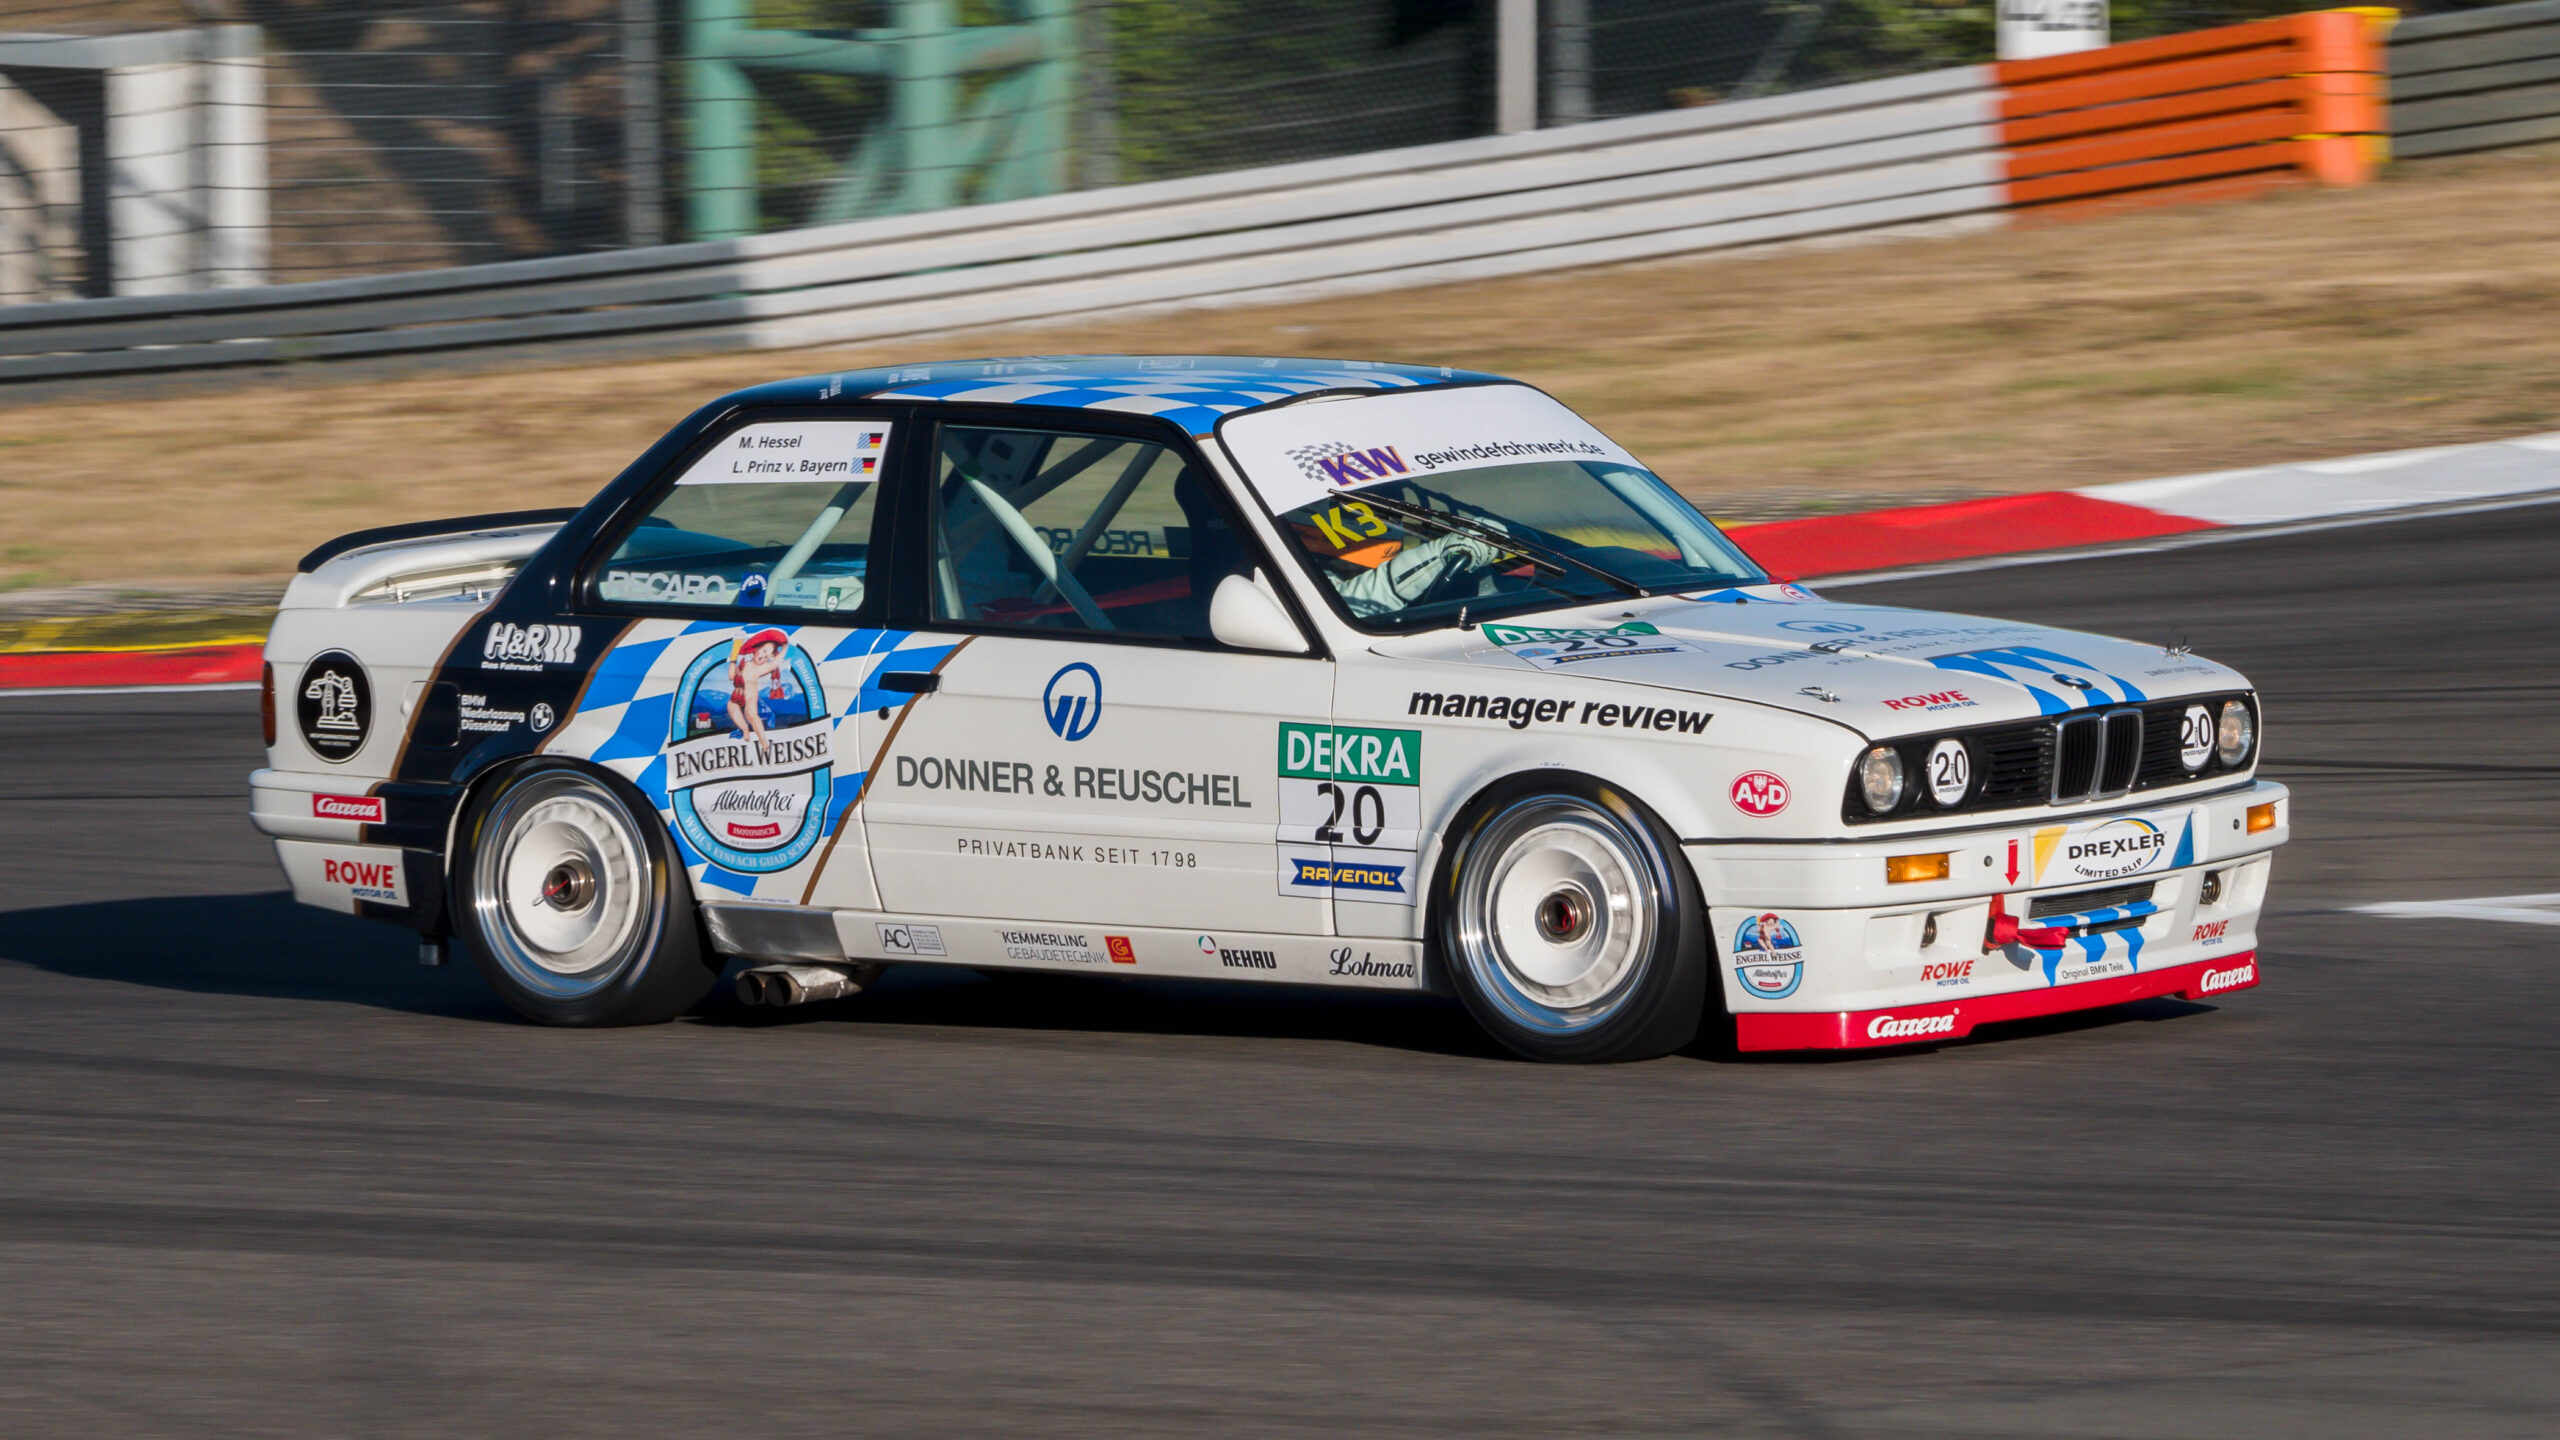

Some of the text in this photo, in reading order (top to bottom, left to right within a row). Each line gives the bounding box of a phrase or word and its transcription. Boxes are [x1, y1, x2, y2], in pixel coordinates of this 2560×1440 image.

[738, 435, 802, 449] M. Hessel
[1317, 445, 1411, 487] KW
[1414, 441, 1605, 470] gewindefahrwerk.de
[732, 460, 848, 477] L. Prinz v. Bayern
[1310, 502, 1388, 550] K3
[606, 571, 727, 600] RECARO
[484, 622, 550, 662] H&R
[1494, 628, 1650, 645] DEKRA
[1549, 637, 1639, 652] 20
[1561, 648, 1668, 663] RAVENOL
[461, 695, 487, 707] BMW
[1883, 690, 1971, 711] ROWE
[1926, 700, 1979, 713] MOTOR OIL
[461, 707, 526, 723] Niederlassung
[1407, 691, 1715, 735] manager review
[461, 719, 511, 732] Düsseldorf
[2181, 713, 2211, 749] 20
[675, 732, 828, 780] ENGERL WEISSE
[1286, 730, 1411, 778] DEKRA
[1935, 750, 1967, 787] 20
[896, 755, 1252, 808] DONNER & REUSCHEL
[316, 797, 378, 817] Carrera
[711, 789, 795, 817] Alkoholfrei
[1315, 782, 1385, 846] 20
[958, 838, 1197, 868] PRIVATBANK SEIT 1798
[2068, 832, 2166, 860] DREXLER
[712, 847, 758, 867] EINFACH
[2074, 857, 2143, 878] LIMITED SLIP
[323, 859, 395, 889] ROWE
[1301, 866, 1395, 886] RAVENOL
[351, 888, 398, 900] MOTOR OIL
[885, 929, 910, 949] AC
[1002, 931, 1088, 948] KEMMERLING
[2192, 919, 2229, 941] ROWE
[1007, 946, 1109, 964] GEBÄUDETECHNIK
[1220, 949, 1277, 969] REHAU
[1329, 947, 1415, 978] Lohmar
[1920, 960, 1975, 982] ROWE
[2061, 962, 2124, 980] Original BMW Teile
[2201, 963, 2254, 992] Carrera
[1936, 979, 1959, 988] MOTOR
[1867, 1014, 1955, 1039] Carrera
